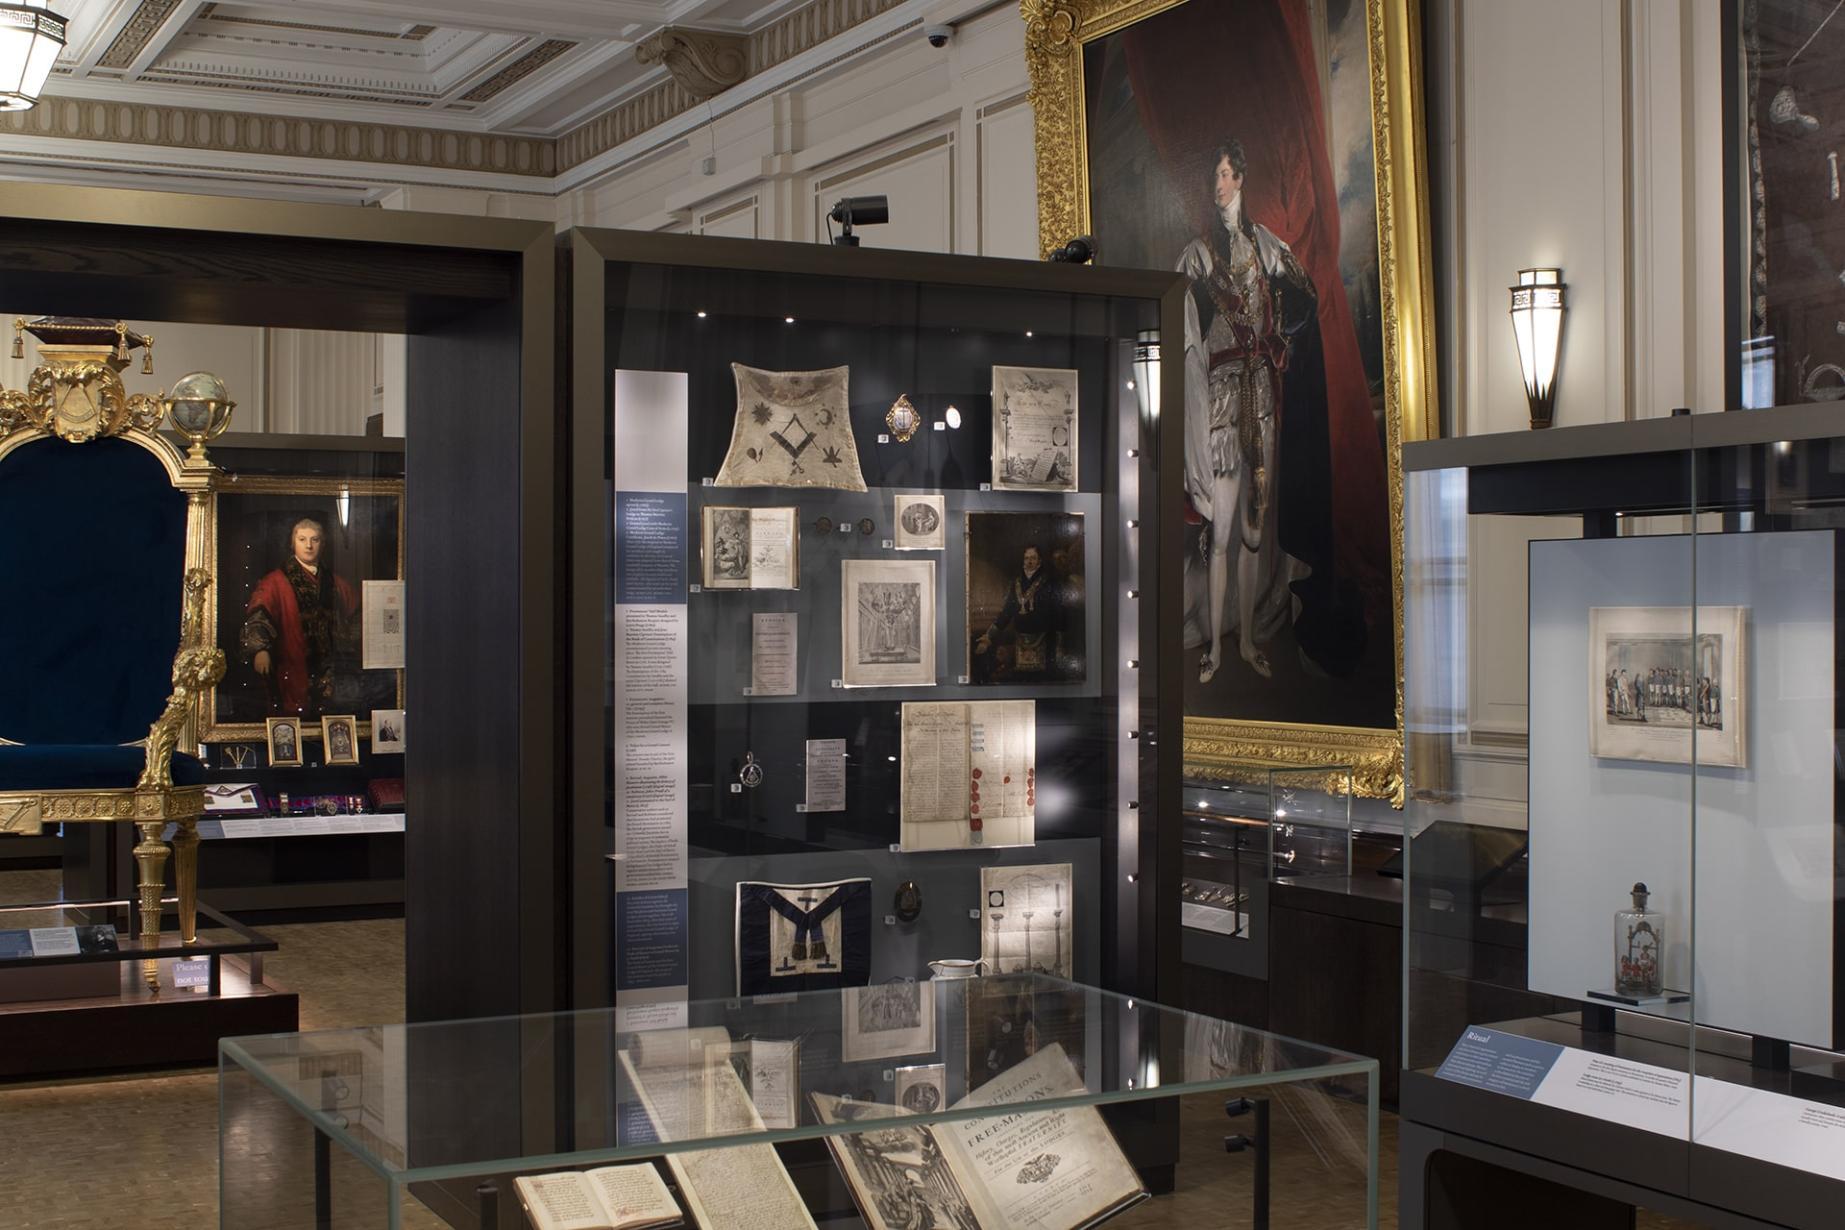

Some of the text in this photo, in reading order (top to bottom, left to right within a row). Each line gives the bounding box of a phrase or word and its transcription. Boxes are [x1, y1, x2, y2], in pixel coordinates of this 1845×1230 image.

[176, 963, 202, 971] Please
[177, 975, 209, 984] not tou
[1466, 1031, 1491, 1043] Ritual
